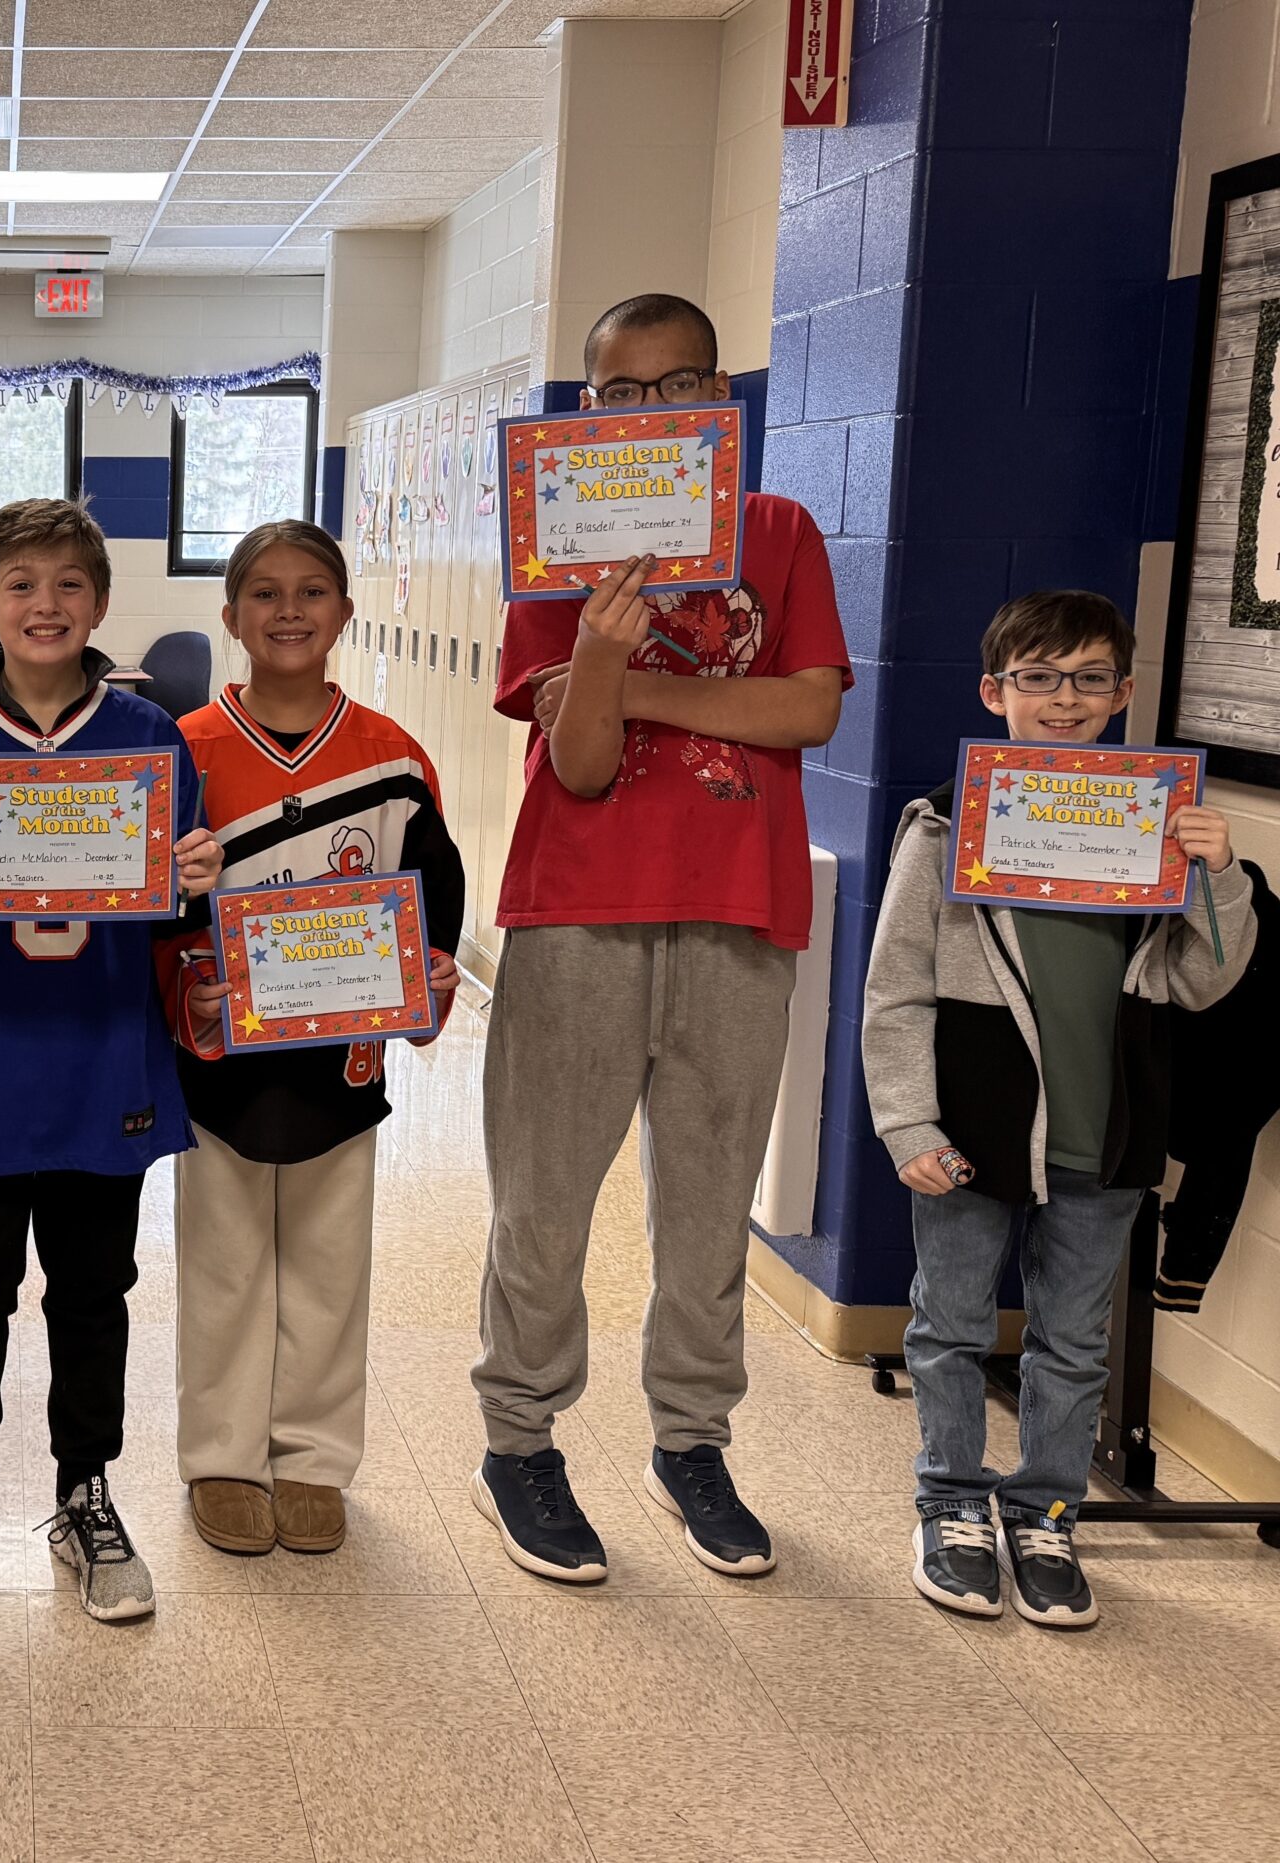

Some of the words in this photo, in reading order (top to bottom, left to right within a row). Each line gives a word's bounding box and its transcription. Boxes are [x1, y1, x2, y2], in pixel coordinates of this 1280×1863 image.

[47, 279, 91, 312] EXIT
[568, 443, 683, 469] Student
[601, 468, 620, 479] of
[622, 466, 649, 477] the
[576, 476, 674, 502] Month
[550, 523, 567, 534] KC
[576, 520, 615, 533] Blasdell
[634, 519, 675, 529] December
[10, 785, 118, 805] Student
[1022, 774, 1136, 798] Student
[284, 796, 301, 805] NLL
[1053, 795, 1071, 806] of
[1073, 796, 1099, 807] the
[42, 806, 59, 817] of
[61, 806, 85, 816] the
[1027, 803, 1125, 827] Month
[18, 816, 110, 835] Month
[1001, 836, 1036, 849] Patrick
[1042, 840, 1062, 851] Yohe
[1080, 843, 1120, 854] December
[22, 853, 67, 863] McMahon
[85, 853, 118, 862] December
[991, 857, 1011, 866] Grade
[1022, 859, 1055, 869] Teachers
[271, 909, 367, 935] Student
[301, 933, 315, 943] of
[317, 931, 340, 940] the
[282, 938, 364, 963] Month
[259, 982, 295, 994] Christine
[299, 980, 321, 989] Lyons
[337, 976, 370, 985] December
[285, 1000, 313, 1008] Teachers
